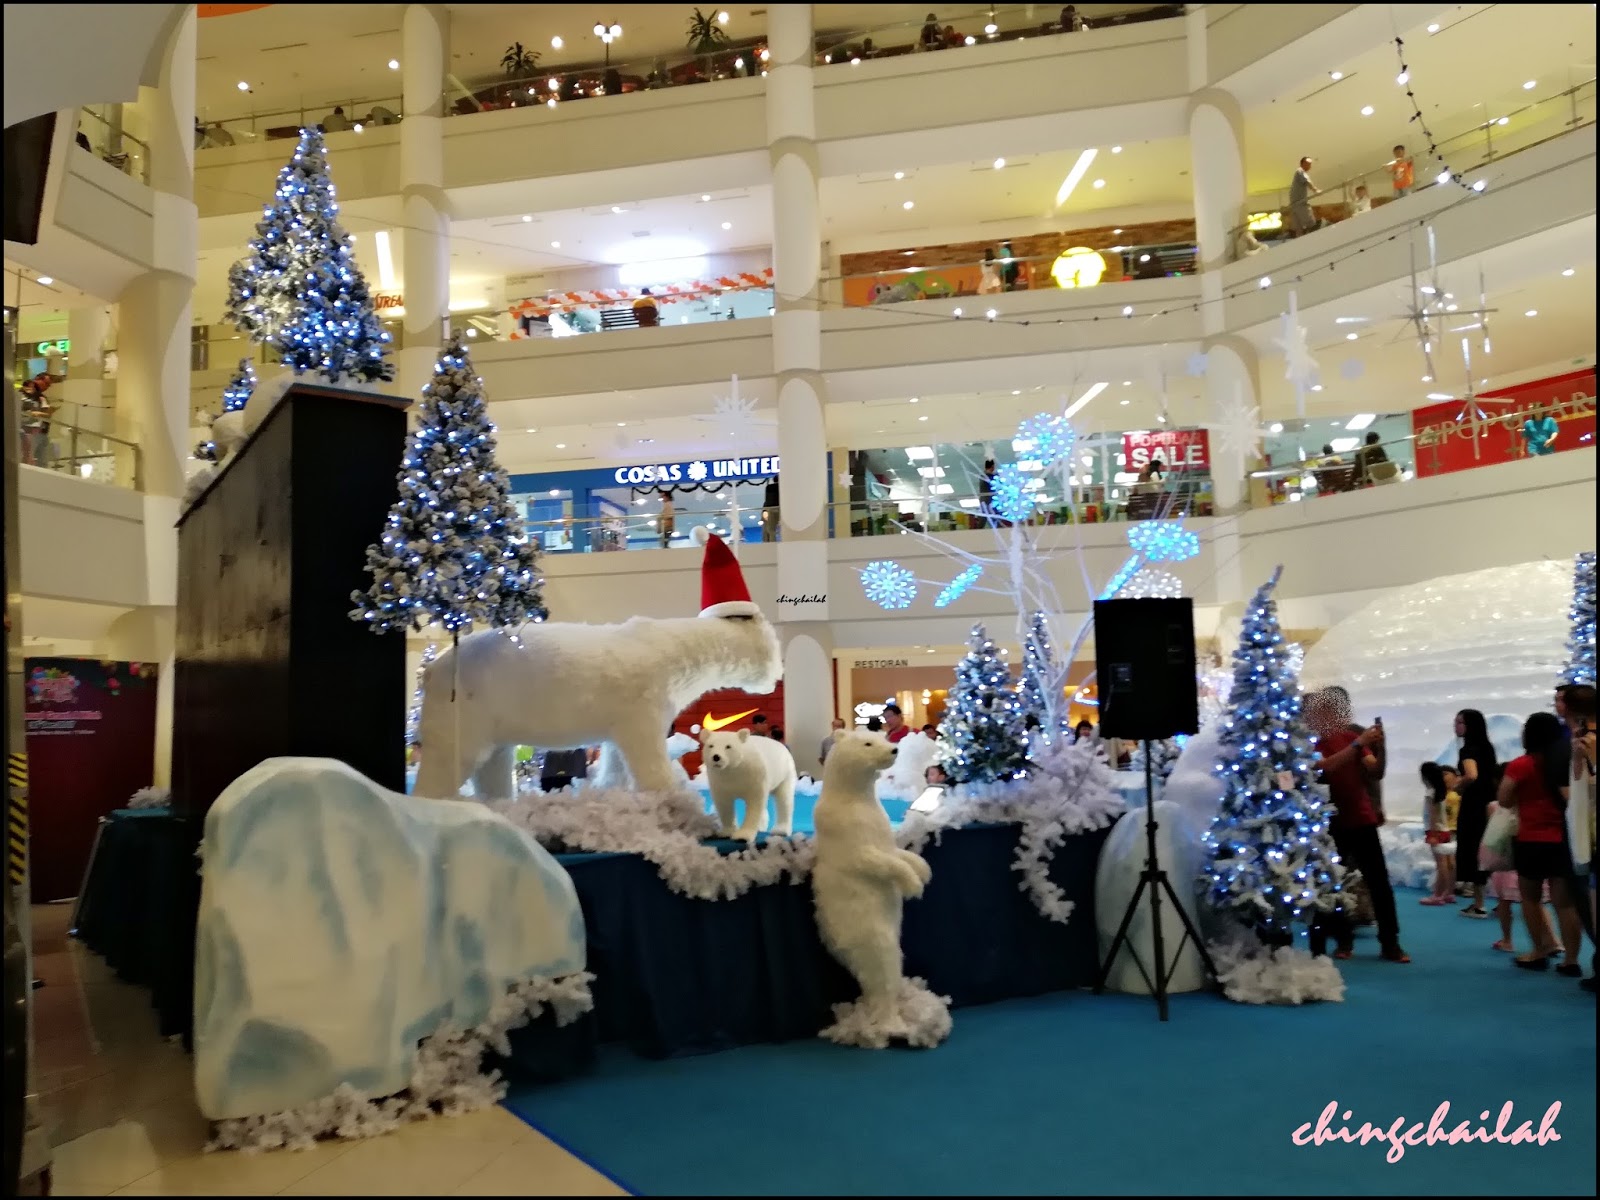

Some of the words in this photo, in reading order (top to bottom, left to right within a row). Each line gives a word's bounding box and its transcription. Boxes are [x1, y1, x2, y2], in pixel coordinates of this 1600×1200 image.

[1131, 444, 1204, 469] SALE
[615, 463, 682, 484] COSAS
[854, 659, 908, 669] RESTORAN
